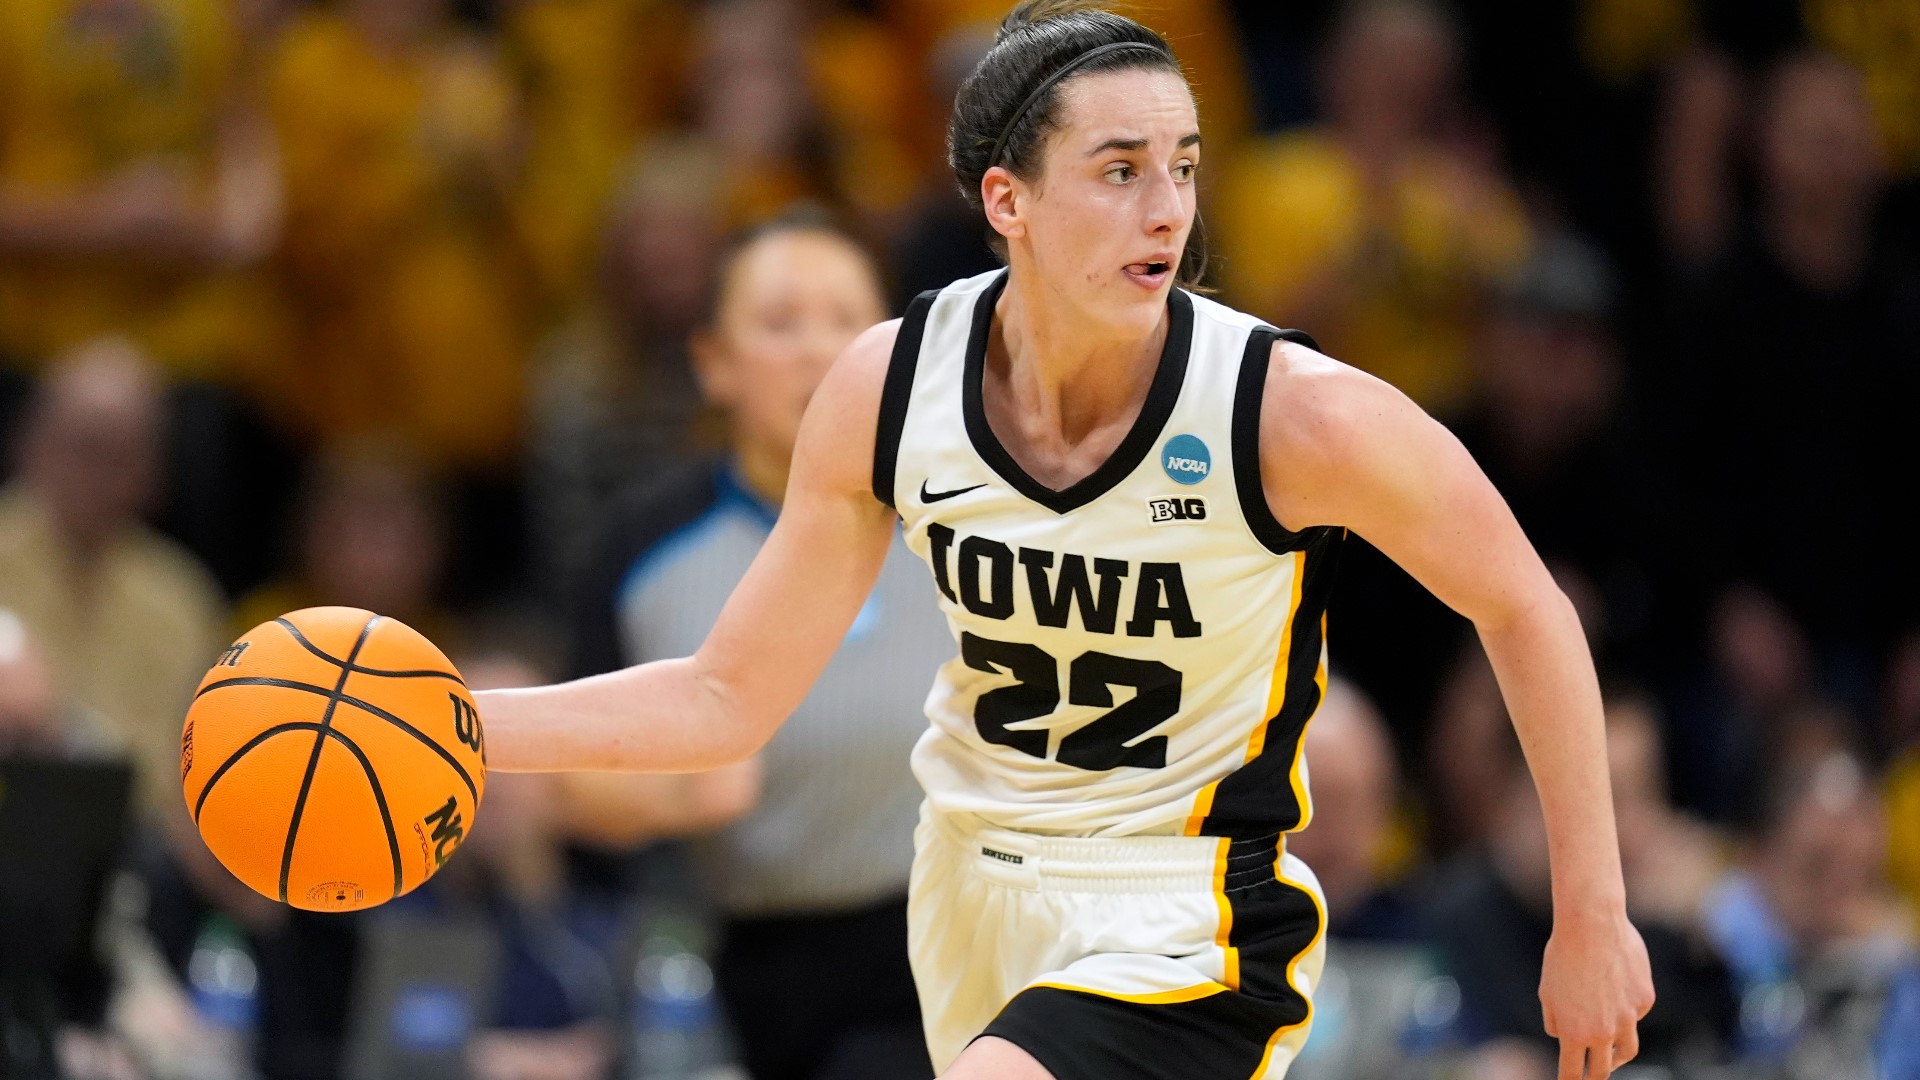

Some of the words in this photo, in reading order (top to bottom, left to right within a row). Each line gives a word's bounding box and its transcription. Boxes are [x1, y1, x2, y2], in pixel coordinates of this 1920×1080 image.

[1167, 456, 1208, 475] NCAA
[927, 522, 1202, 638] IOWA
[961, 630, 1183, 771] 22
